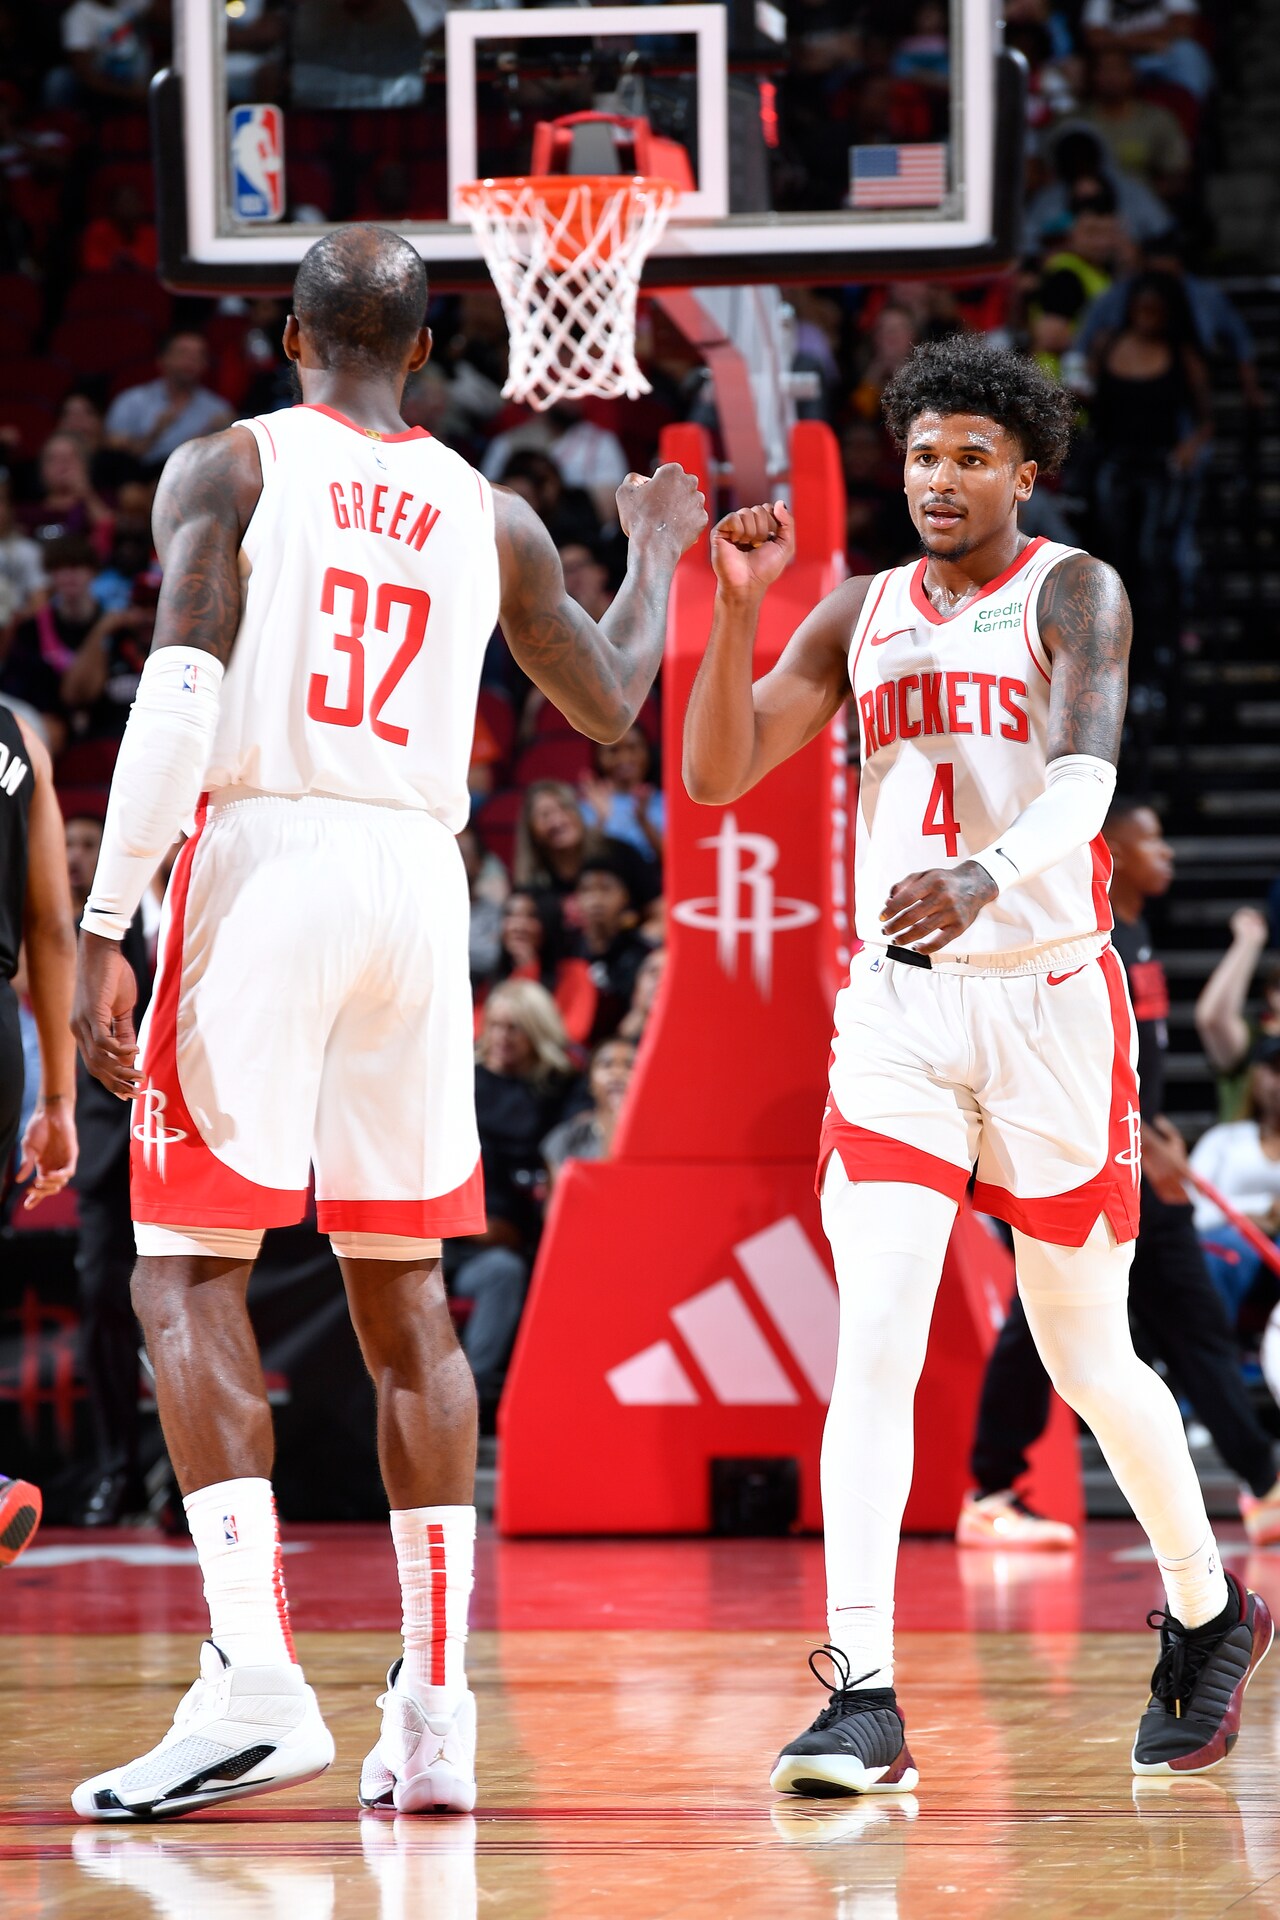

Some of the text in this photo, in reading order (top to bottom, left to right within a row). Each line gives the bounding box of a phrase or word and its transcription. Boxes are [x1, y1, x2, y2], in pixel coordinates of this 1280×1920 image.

[330, 482, 440, 552] GREEN
[973, 618, 1021, 633] karma
[978, 602, 1023, 620] credit
[306, 567, 431, 747] 32
[859, 671, 1030, 759] ROCKETS
[922, 762, 961, 858] 4
